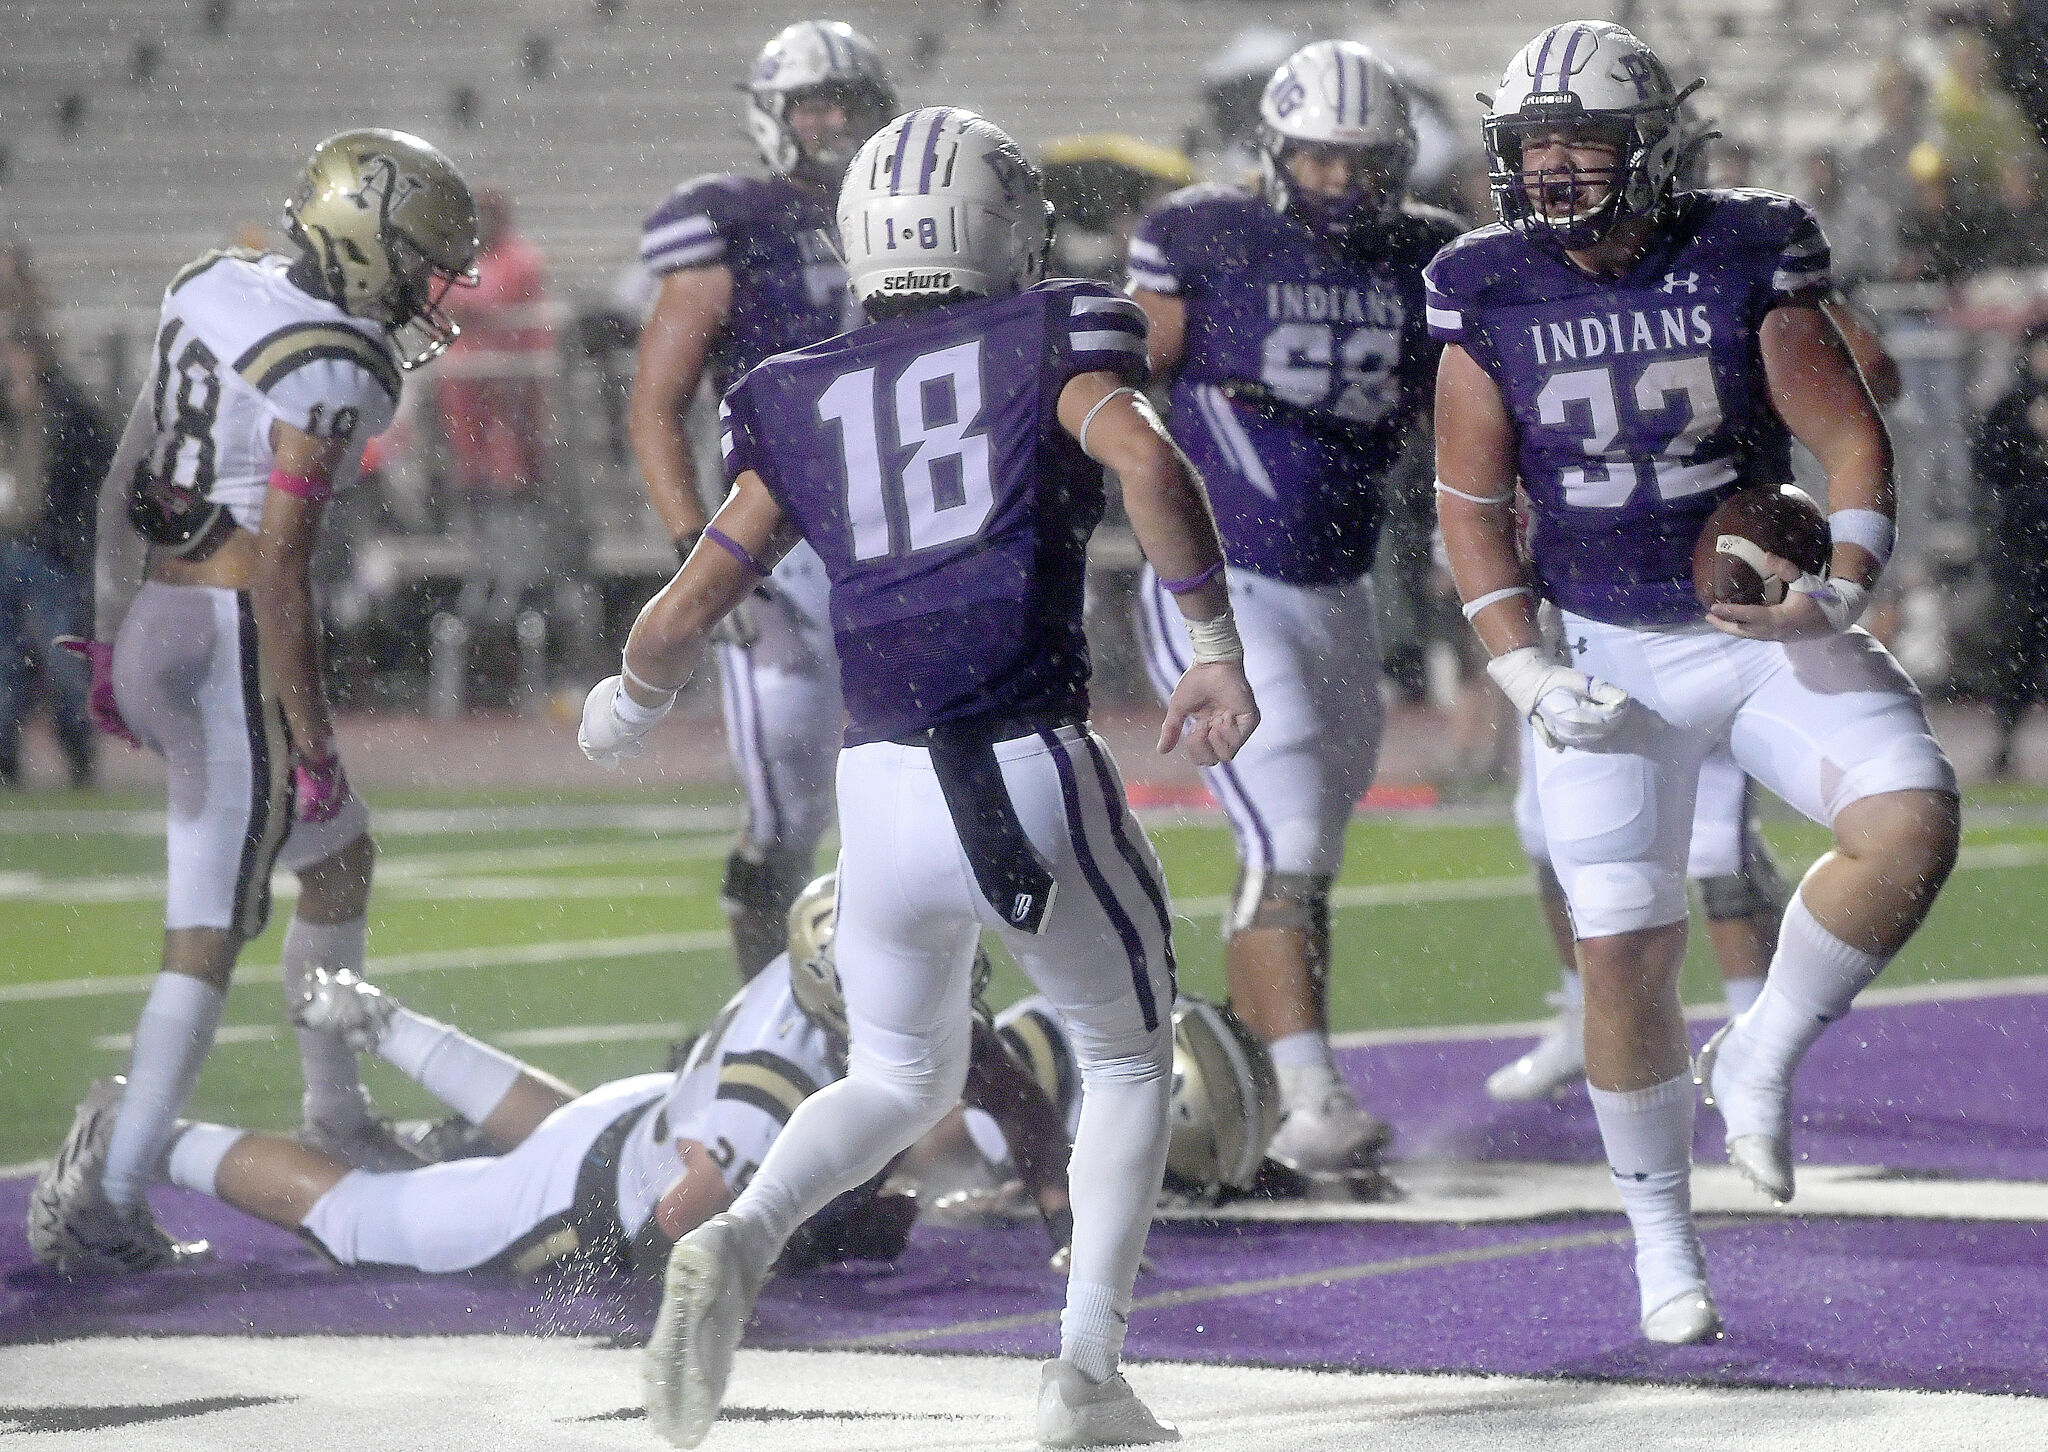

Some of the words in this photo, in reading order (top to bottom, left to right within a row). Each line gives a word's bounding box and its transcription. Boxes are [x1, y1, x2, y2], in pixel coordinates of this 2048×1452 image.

[884, 271, 952, 290] schutt
[1267, 282, 1405, 326] INDIANS
[1531, 305, 1712, 364] INDIANS
[152, 316, 221, 498] 18
[817, 340, 995, 561] 18
[1537, 356, 1739, 508] 32
